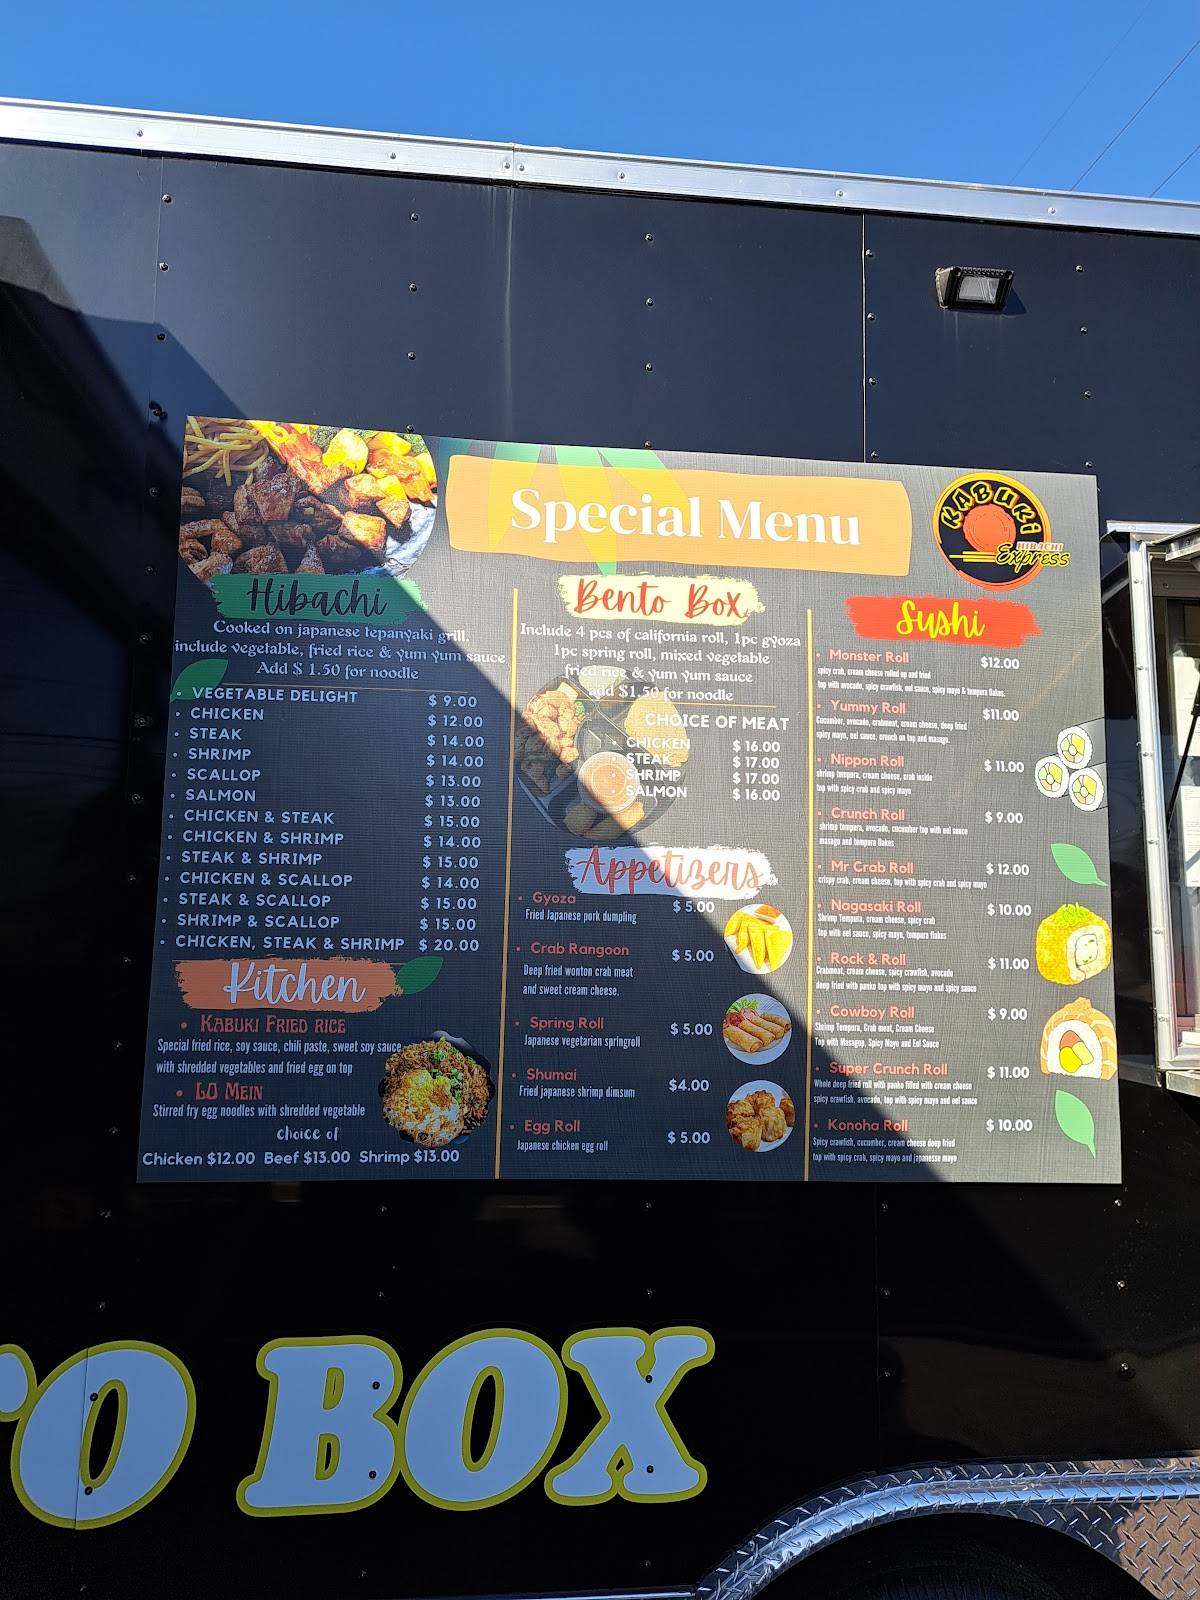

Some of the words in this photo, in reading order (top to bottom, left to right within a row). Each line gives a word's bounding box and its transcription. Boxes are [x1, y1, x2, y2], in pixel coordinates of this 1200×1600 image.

[941, 481, 1042, 535] KABUKI
[510, 487, 702, 545] Special
[718, 499, 861, 546] Menu
[1016, 541, 1064, 551] HIBACHI
[995, 543, 1071, 574] Express
[246, 577, 388, 618] Hibachi
[573, 578, 672, 616] Bento
[684, 583, 750, 619] Box
[896, 600, 986, 639] Sushi
[213, 620, 270, 635] Cooked
[275, 623, 294, 635] on
[297, 624, 360, 640] japanese
[365, 626, 433, 642] tepanyaki
[437, 629, 470, 646] grill.
[520, 622, 572, 638] Include
[576, 625, 585, 638] 4
[589, 628, 612, 641] pcs
[617, 628, 631, 642] of
[634, 628, 697, 643] california
[702, 631, 729, 646] roll,
[734, 631, 758, 647] 1pc
[762, 635, 801, 648] gyoza
[175, 640, 227, 653] include
[231, 642, 304, 658] vegetable,
[308, 643, 342, 659] fried
[346, 646, 375, 658] rice
[379, 646, 391, 658] &
[396, 648, 426, 663] yum
[431, 649, 462, 664] yum
[465, 651, 506, 664] sauce
[554, 644, 578, 658] 1pc
[582, 646, 626, 661] spring
[629, 647, 656, 662] roll,
[660, 649, 702, 662] mixed
[706, 650, 770, 667] vegetable
[829, 649, 882, 662] Monster
[886, 651, 909, 664] Roll
[256, 661, 288, 675] Add
[345, 664, 366, 679] for
[370, 666, 419, 680] noodle
[980, 656, 1020, 670] $12.00
[192, 687, 284, 701] VEGETABLE
[290, 689, 358, 703] DELIGHT
[190, 707, 264, 721] CHICKEN
[831, 700, 878, 715] Yummy
[882, 702, 906, 714] Roll
[982, 708, 1020, 722] $11.00
[645, 713, 710, 728] CHOICE
[716, 715, 736, 729] OF
[742, 716, 790, 731] MEAT
[189, 727, 242, 740] STEAK
[626, 736, 691, 750] CHICKEN
[188, 748, 252, 761] SHRIMP
[626, 752, 671, 765] STEAK
[830, 754, 877, 768] Nippon
[880, 756, 904, 768] Roll
[187, 768, 261, 781] SCALLOP
[625, 769, 681, 782] SHRIMP
[185, 789, 256, 802] SALMON
[625, 785, 687, 798] SALMON
[184, 810, 258, 823] CHICKEN
[264, 811, 275, 823] &
[281, 811, 334, 825] STEAK
[831, 808, 877, 820] Crunch
[881, 809, 905, 821] Roll
[577, 845, 764, 894] Appetizers
[831, 860, 850, 872] Mr
[854, 861, 886, 874] Crab
[889, 862, 914, 874] Roll
[818, 876, 835, 885] crispy
[894, 878, 903, 887] top
[905, 878, 916, 886] with
[918, 878, 931, 888] spicy
[933, 879, 945, 887] crab
[946, 879, 956, 887] and
[958, 879, 971, 889] spicy
[973, 881, 987, 889] mayo
[532, 892, 576, 905] Gyoza
[831, 899, 893, 914] Nagasaki
[896, 900, 921, 913] Roll
[525, 909, 544, 921] Fried
[546, 910, 581, 923] Japanese
[583, 910, 601, 923] pork
[603, 911, 637, 925] dumpling
[175, 935, 256, 950] CHICKEN,
[263, 936, 317, 950] STEAK
[323, 937, 334, 950] &
[340, 938, 405, 951] SHRIMP
[531, 942, 565, 955] Crab
[569, 943, 629, 958] Rangoon
[830, 953, 864, 965] Rock
[868, 953, 878, 966] &
[881, 954, 906, 966] Roll
[223, 961, 366, 1005] Kitchen
[830, 1005, 885, 1021] Cowboy
[890, 1006, 914, 1019] Roll
[529, 1017, 576, 1032] Spring
[578, 1017, 604, 1030] Roll
[815, 1022, 834, 1033] Shrimp
[864, 1023, 876, 1032] Crab
[895, 1024, 913, 1033] Cream
[915, 1024, 935, 1033] Cheese
[157, 1038, 189, 1052] Special
[192, 1039, 211, 1052] fried
[213, 1040, 233, 1054] rice,
[236, 1041, 251, 1055] soy
[253, 1042, 281, 1055] sauce,
[283, 1040, 302, 1053] chili
[304, 1041, 330, 1055] paste,
[333, 1041, 358, 1053] sweet
[360, 1042, 375, 1055] soy
[377, 1042, 401, 1053] sauce
[524, 1035, 559, 1048] Japanese
[562, 1036, 602, 1049] vegetarian
[604, 1036, 641, 1049] springroll
[526, 1068, 577, 1081] Shumai
[829, 1063, 869, 1077] Super
[872, 1064, 920, 1076] Crunch
[923, 1064, 948, 1076] Roll
[668, 1079, 709, 1092] $4.00
[153, 1104, 184, 1117] Stirred
[187, 1104, 199, 1119] fry
[201, 1108, 218, 1120] egg
[220, 1104, 255, 1117] noodles
[257, 1104, 277, 1117] with
[279, 1104, 320, 1117] shredded
[322, 1104, 365, 1119] vegetable
[277, 1125, 321, 1141] choice
[326, 1127, 339, 1142] of
[524, 1120, 551, 1134] Egg
[554, 1120, 581, 1132] Roll
[828, 1120, 880, 1132] Konoha
[884, 1120, 908, 1132] Roll
[142, 1151, 203, 1166] Chicken
[207, 1151, 256, 1166] $12.00
[264, 1151, 299, 1165] Beef
[303, 1151, 350, 1166] $13.00
[359, 1151, 410, 1167] Shrimp
[414, 1150, 460, 1164] $13.00
[236, 1326, 715, 1517] BOX
